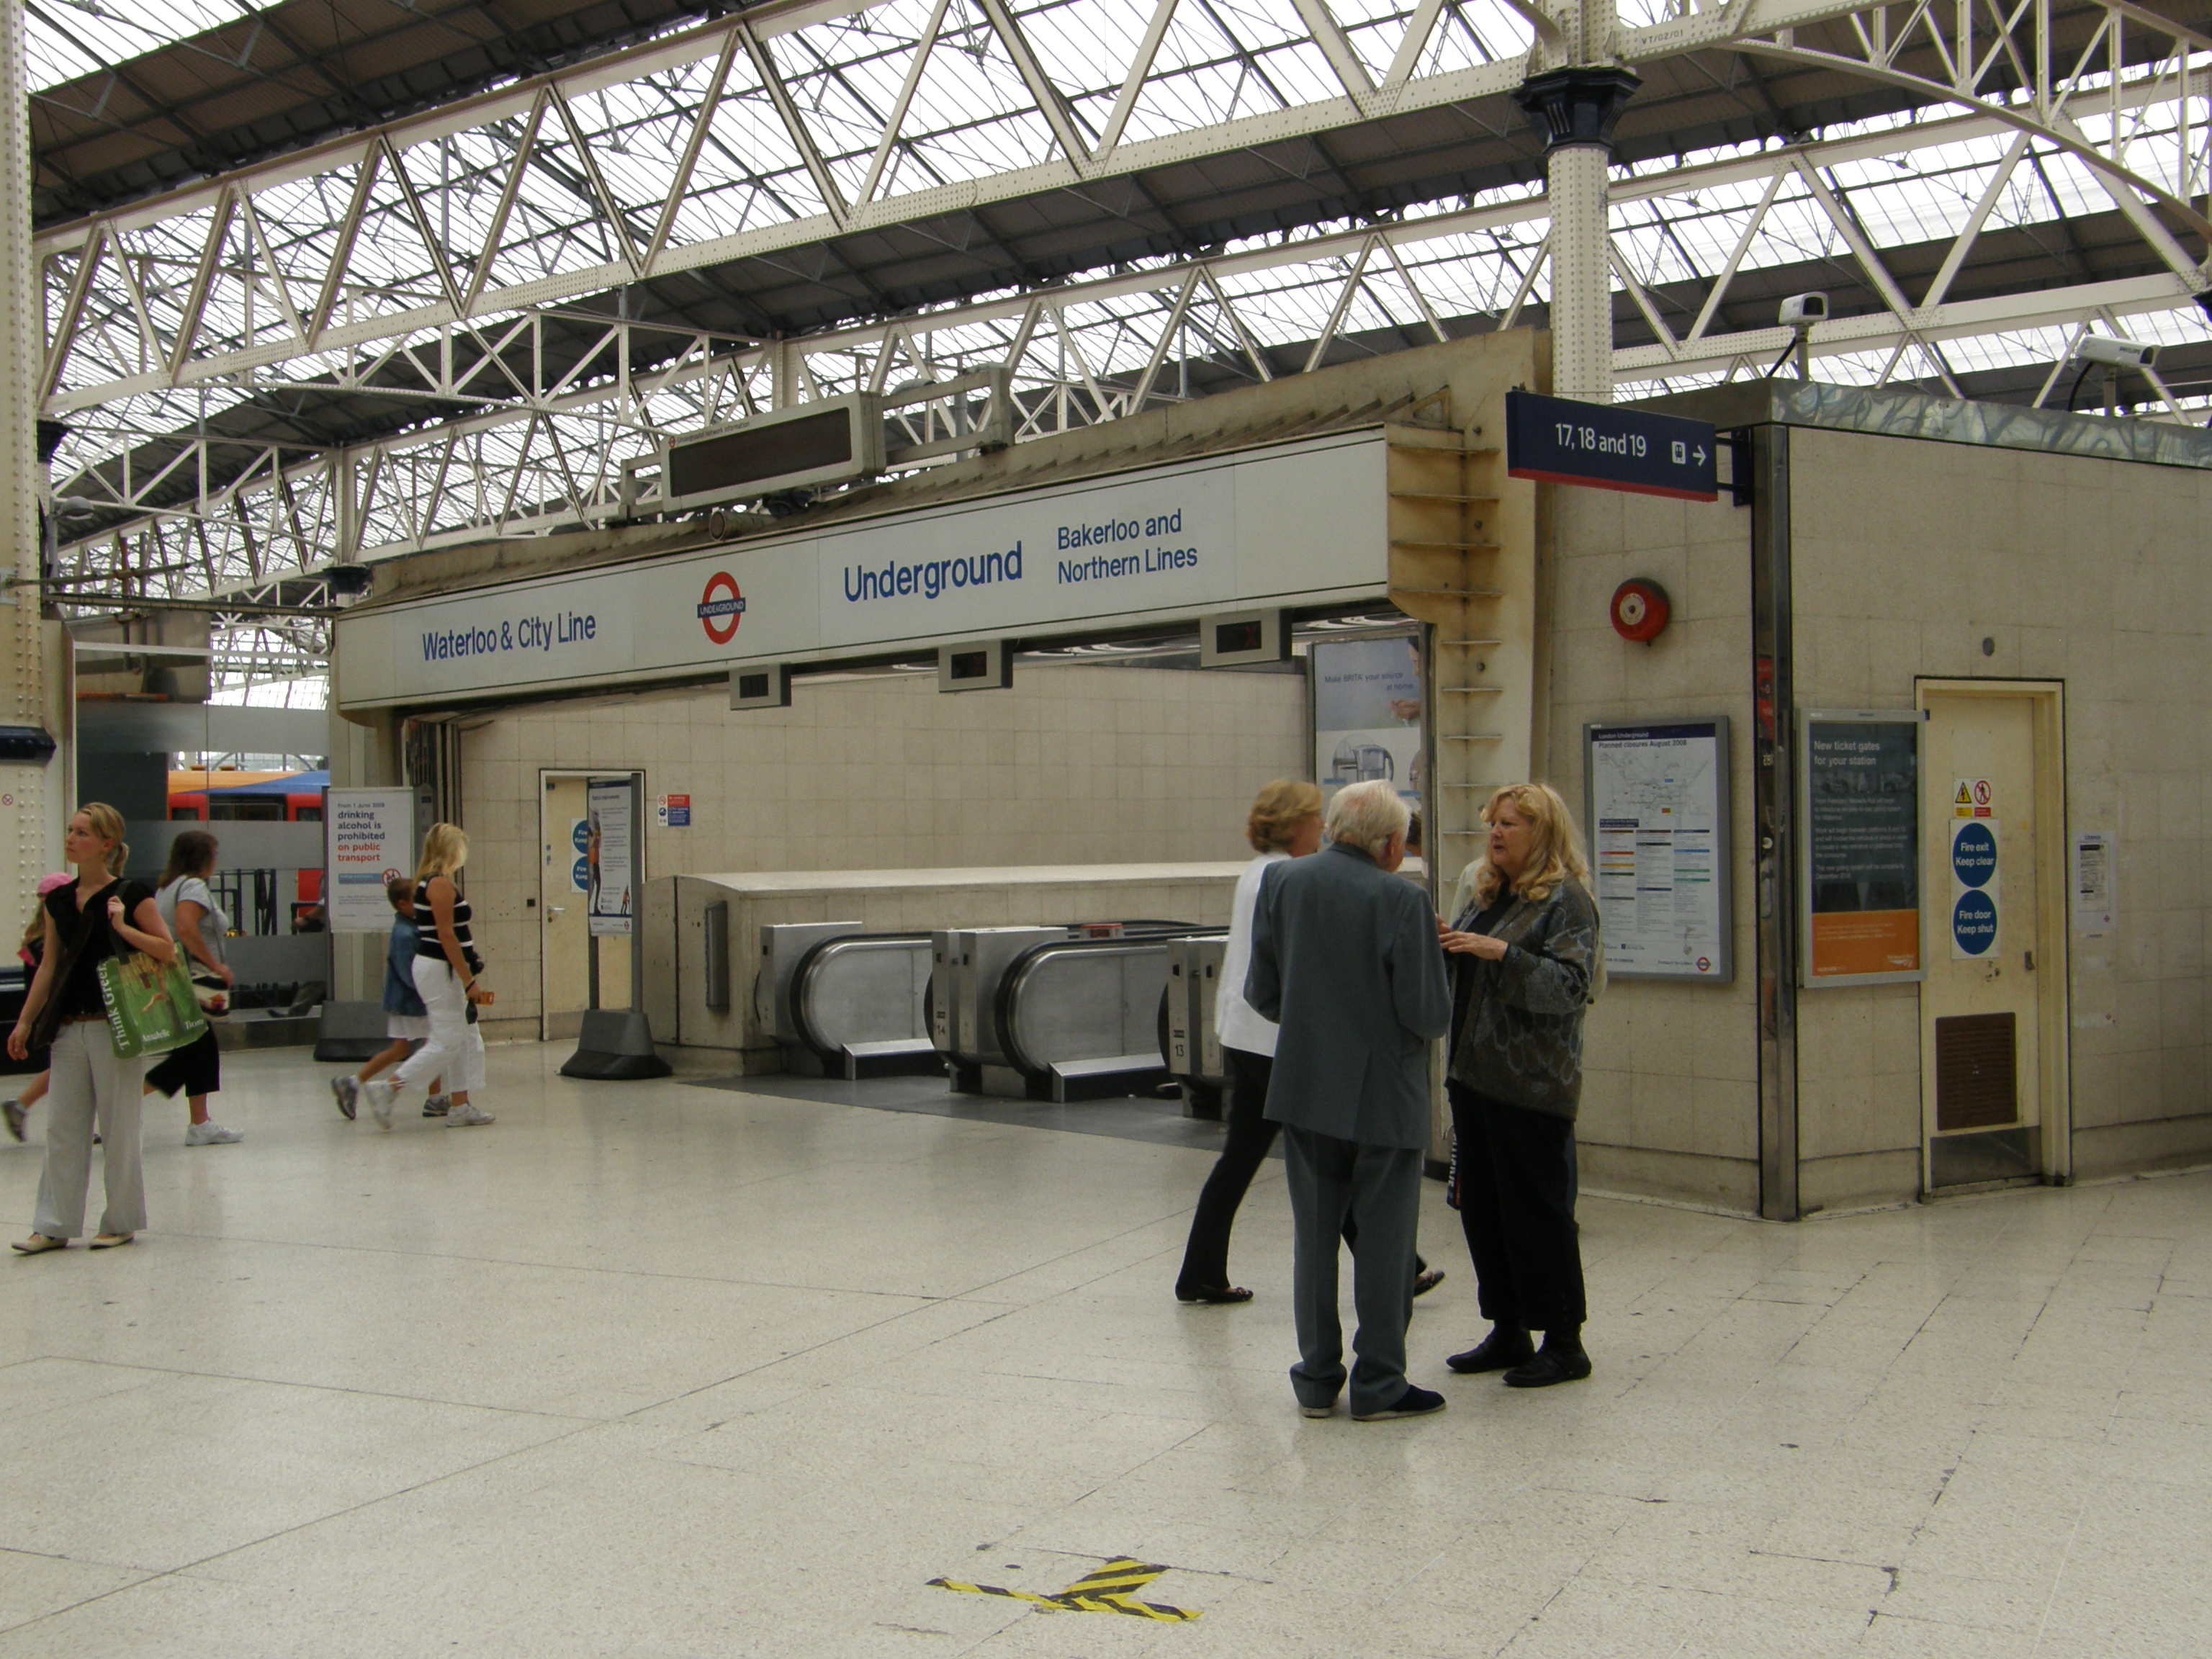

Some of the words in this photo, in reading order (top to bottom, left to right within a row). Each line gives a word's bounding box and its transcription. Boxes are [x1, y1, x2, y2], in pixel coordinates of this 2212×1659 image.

[1555, 423, 1575, 451] 17,
[1578, 427, 1596, 450] 18
[1599, 433, 1627, 455] and
[1629, 434, 1647, 457] 19
[1058, 518, 1140, 550] Bakerloo
[1145, 508, 1182, 537] and
[844, 540, 1022, 602] Underground
[1058, 555, 1140, 584] Northern
[1146, 547, 1198, 572] Lines
[699, 601, 744, 616] UNDERGROUND
[423, 626, 497, 661] Waterloo
[500, 620, 513, 650] &
[518, 616, 552, 652] City
[557, 611, 596, 644] Line
[1814, 741, 1833, 750] New
[1834, 740, 1856, 750] ticket
[1858, 741, 1880, 753] gates
[1814, 756, 1825, 765] for
[1828, 757, 1847, 768] your
[1848, 756, 1876, 765] station
[338, 811, 374, 820] drinking
[338, 821, 372, 830] alcohol
[338, 832, 385, 842] prohibited
[353, 843, 380, 853] public
[1961, 842, 1974, 852] Fire
[1976, 842, 1989, 851] exit
[338, 854, 381, 863] transport
[1956, 857, 1974, 867] Keep
[1976, 856, 1994, 866] clear
[1959, 911, 1973, 920] Fire
[1974, 910, 1991, 919] door
[1957, 925, 1976, 935] Keep
[1977, 924, 1993, 933] shut
[108, 1007, 130, 1051] Think
[1174, 1044, 1184, 1057] 13
